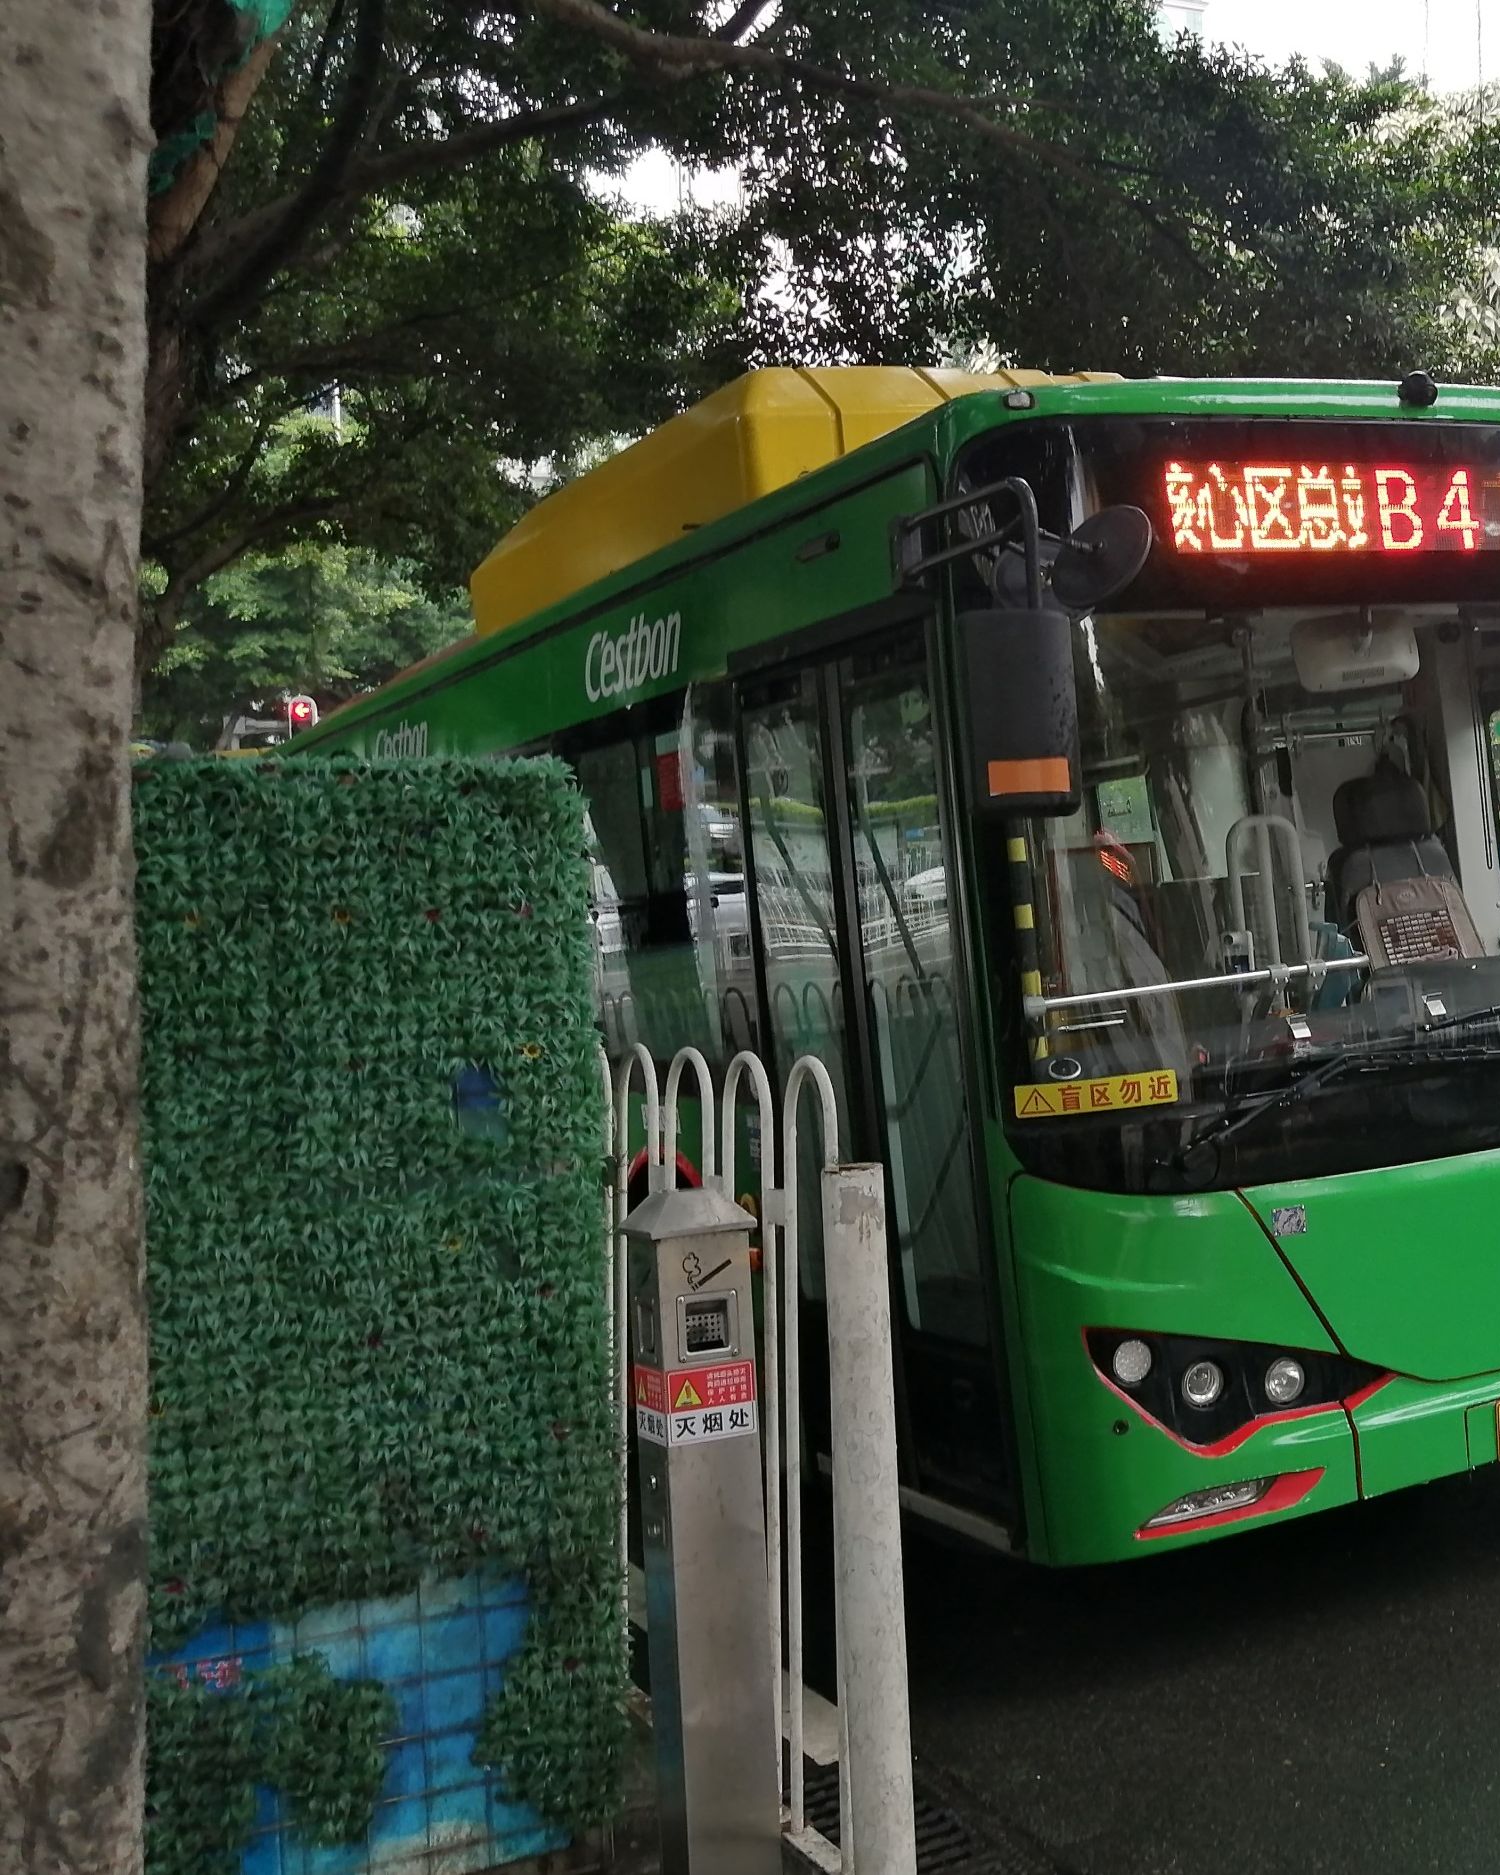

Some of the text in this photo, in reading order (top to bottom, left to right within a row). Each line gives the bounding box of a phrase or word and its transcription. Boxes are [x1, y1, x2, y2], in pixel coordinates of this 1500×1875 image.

[1057, 1074, 1173, 1112] 盲区勿近
[675, 1408, 749, 1438] 灭烟处
